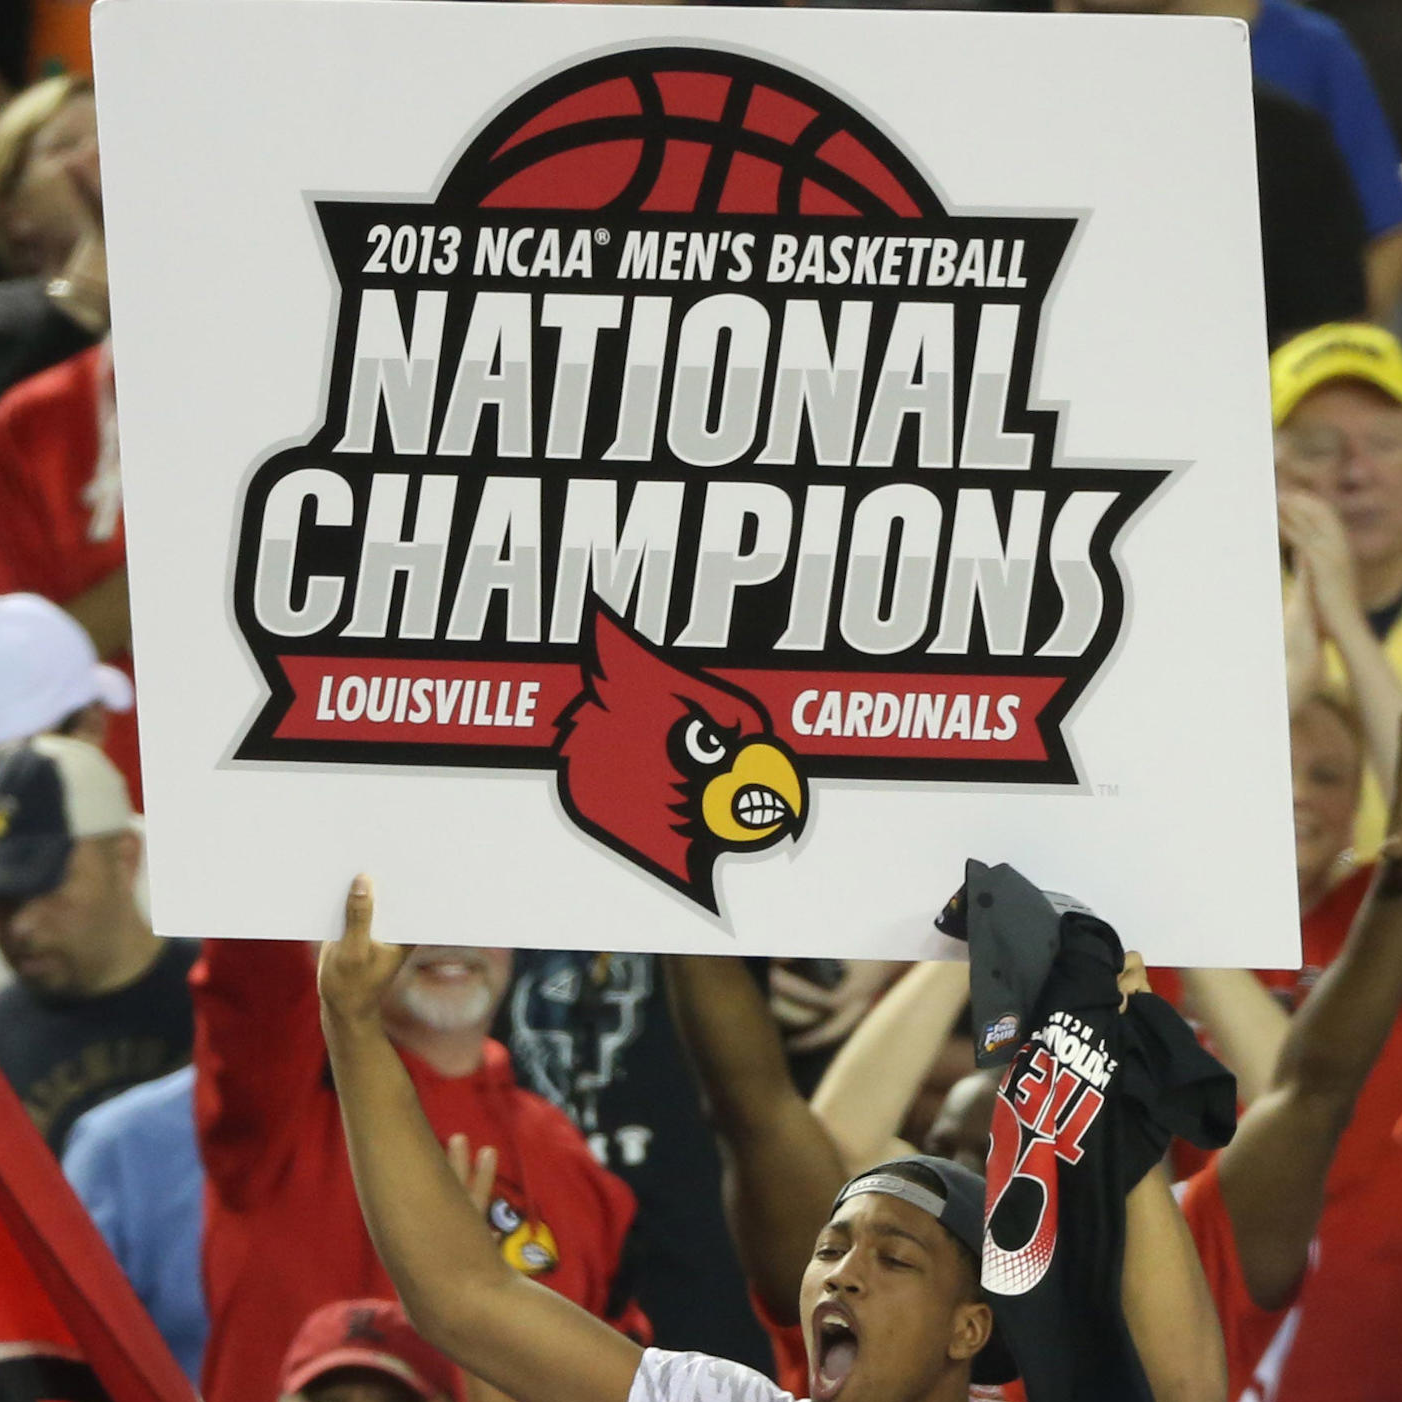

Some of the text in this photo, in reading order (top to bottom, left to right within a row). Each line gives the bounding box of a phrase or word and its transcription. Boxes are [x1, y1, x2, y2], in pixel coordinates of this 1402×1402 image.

[362, 224, 462, 275] 2013
[616, 230, 755, 282] MEN'S
[766, 233, 1027, 288] BASKETBALL
[333, 287, 1035, 470] NATIONAL
[253, 467, 1120, 659] CHAMPIONS
[316, 675, 1020, 741] LOUISVILLE CARDINALS
